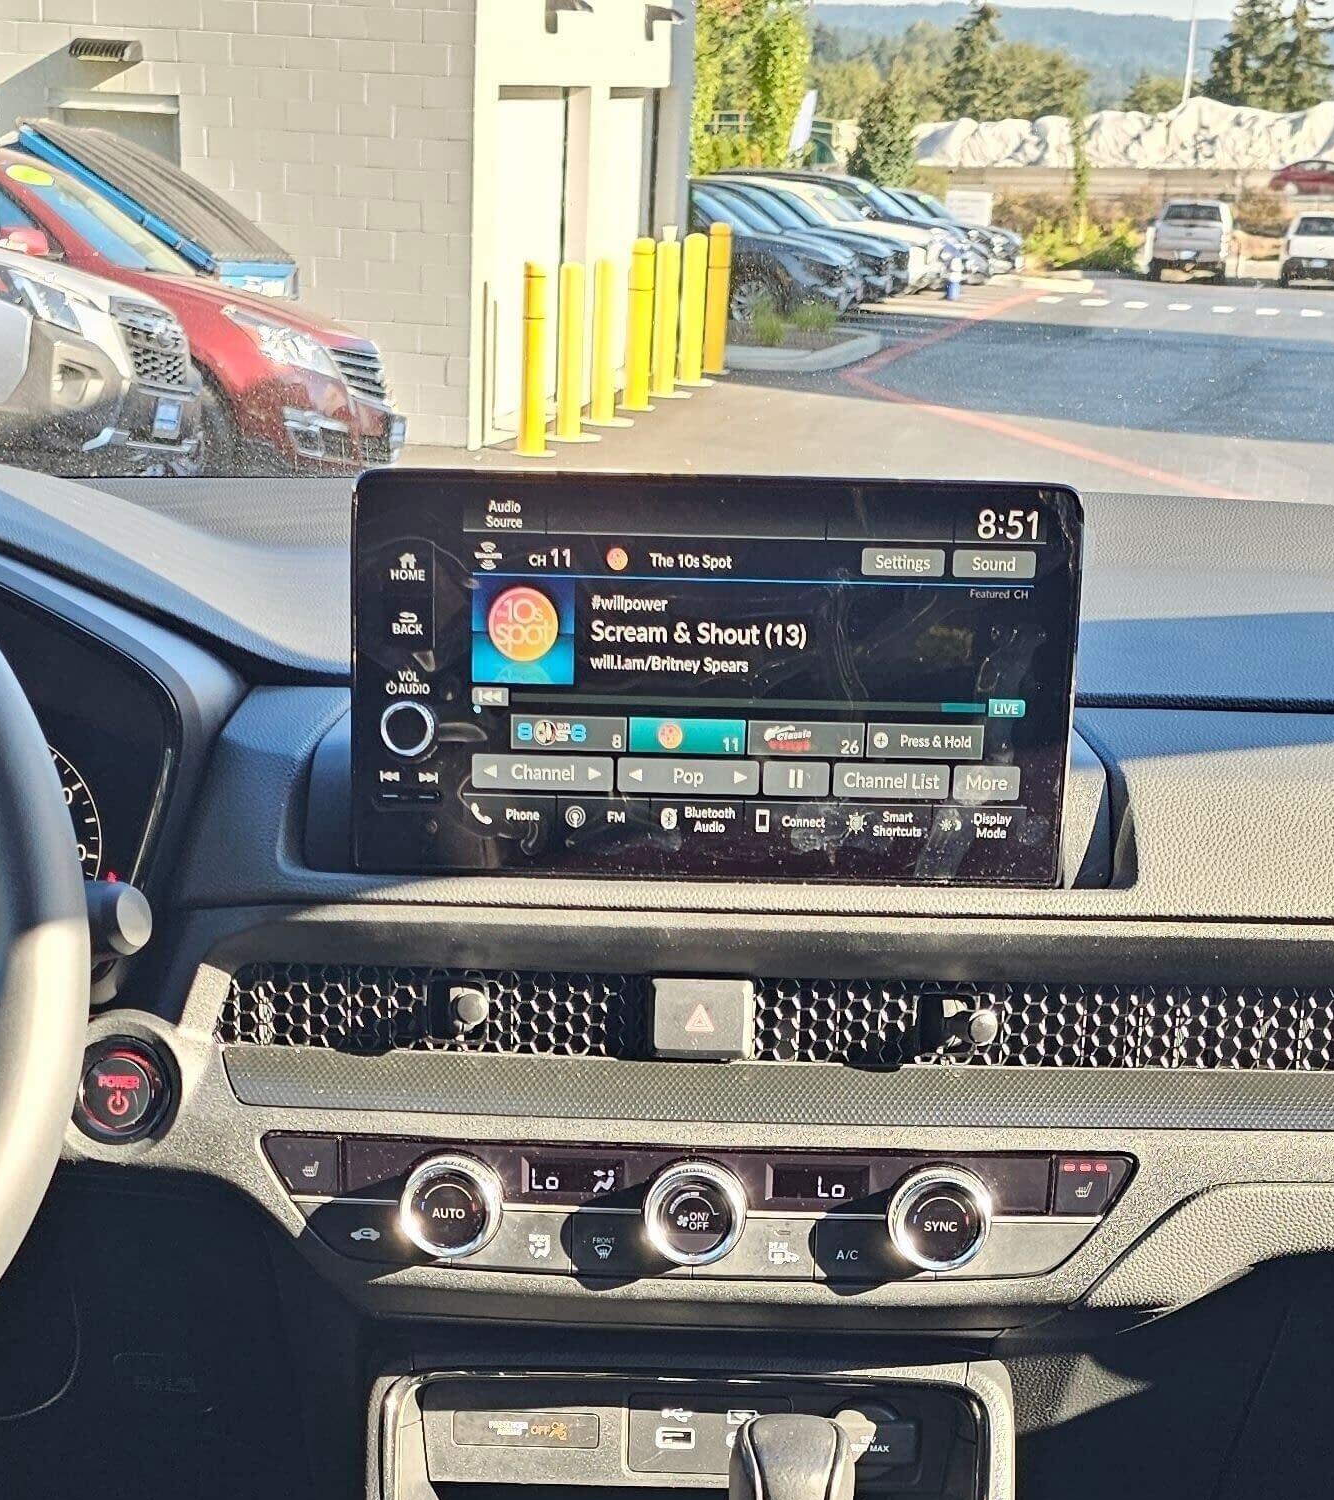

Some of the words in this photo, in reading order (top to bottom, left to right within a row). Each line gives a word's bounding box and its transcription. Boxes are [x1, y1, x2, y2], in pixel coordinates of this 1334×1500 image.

[489, 500, 521, 514] Audio
[485, 515, 523, 529] Source
[977, 508, 1039, 540] 8:51
[528, 554, 547, 567] CH
[551, 548, 571, 568] 11
[649, 552, 674, 568] The
[677, 553, 699, 569] 10s
[702, 555, 732, 571] Spot
[875, 554, 931, 573] Settings
[972, 556, 1016, 572] Sound
[390, 569, 426, 582] HOME
[969, 589, 1010, 600] Featured
[1013, 589, 1029, 600] CH
[591, 595, 668, 613] #willpower
[392, 623, 423, 635] BACK
[590, 620, 668, 644] Scream
[673, 621, 692, 645] &
[696, 621, 760, 645] Shout
[764, 622, 807, 650] (13)
[702, 656, 749, 675] Spears
[398, 671, 419, 682] VOL
[398, 683, 430, 695] AUDIO
[993, 703, 1019, 715] LIVE
[611, 734, 623, 749] 8
[722, 737, 739, 752] 11
[840, 740, 860, 755] 26
[900, 734, 930, 749] Press
[931, 735, 942, 749] &
[944, 735, 972, 749] Hold
[510, 763, 575, 782] Channel
[673, 767, 704, 787] Pop
[843, 771, 908, 790] Channel
[912, 773, 940, 790] List
[965, 775, 1008, 791] More
[505, 808, 540, 822] Phone
[607, 811, 625, 824] FM
[684, 806, 736, 821] Bluetooth
[882, 811, 914, 824] Smart
[973, 813, 1012, 828] Display
[693, 820, 726, 833] Audio
[781, 815, 826, 829] Connect
[872, 825, 922, 838] Shortcuts
[976, 826, 1007, 839] Mode
[98, 1075, 140, 1089] POWER
[531, 1168, 559, 1191] Lo
[817, 1176, 846, 1198] Lo
[431, 1207, 466, 1220] AUTO
[689, 1212, 709, 1223] ON/
[689, 1221, 710, 1231] OFF
[924, 1221, 958, 1233] SYNC
[592, 1236, 616, 1244] FRONT
[836, 1250, 859, 1260] A/C
[530, 1426, 552, 1435] OFF
[869, 1445, 890, 1453] MAX
